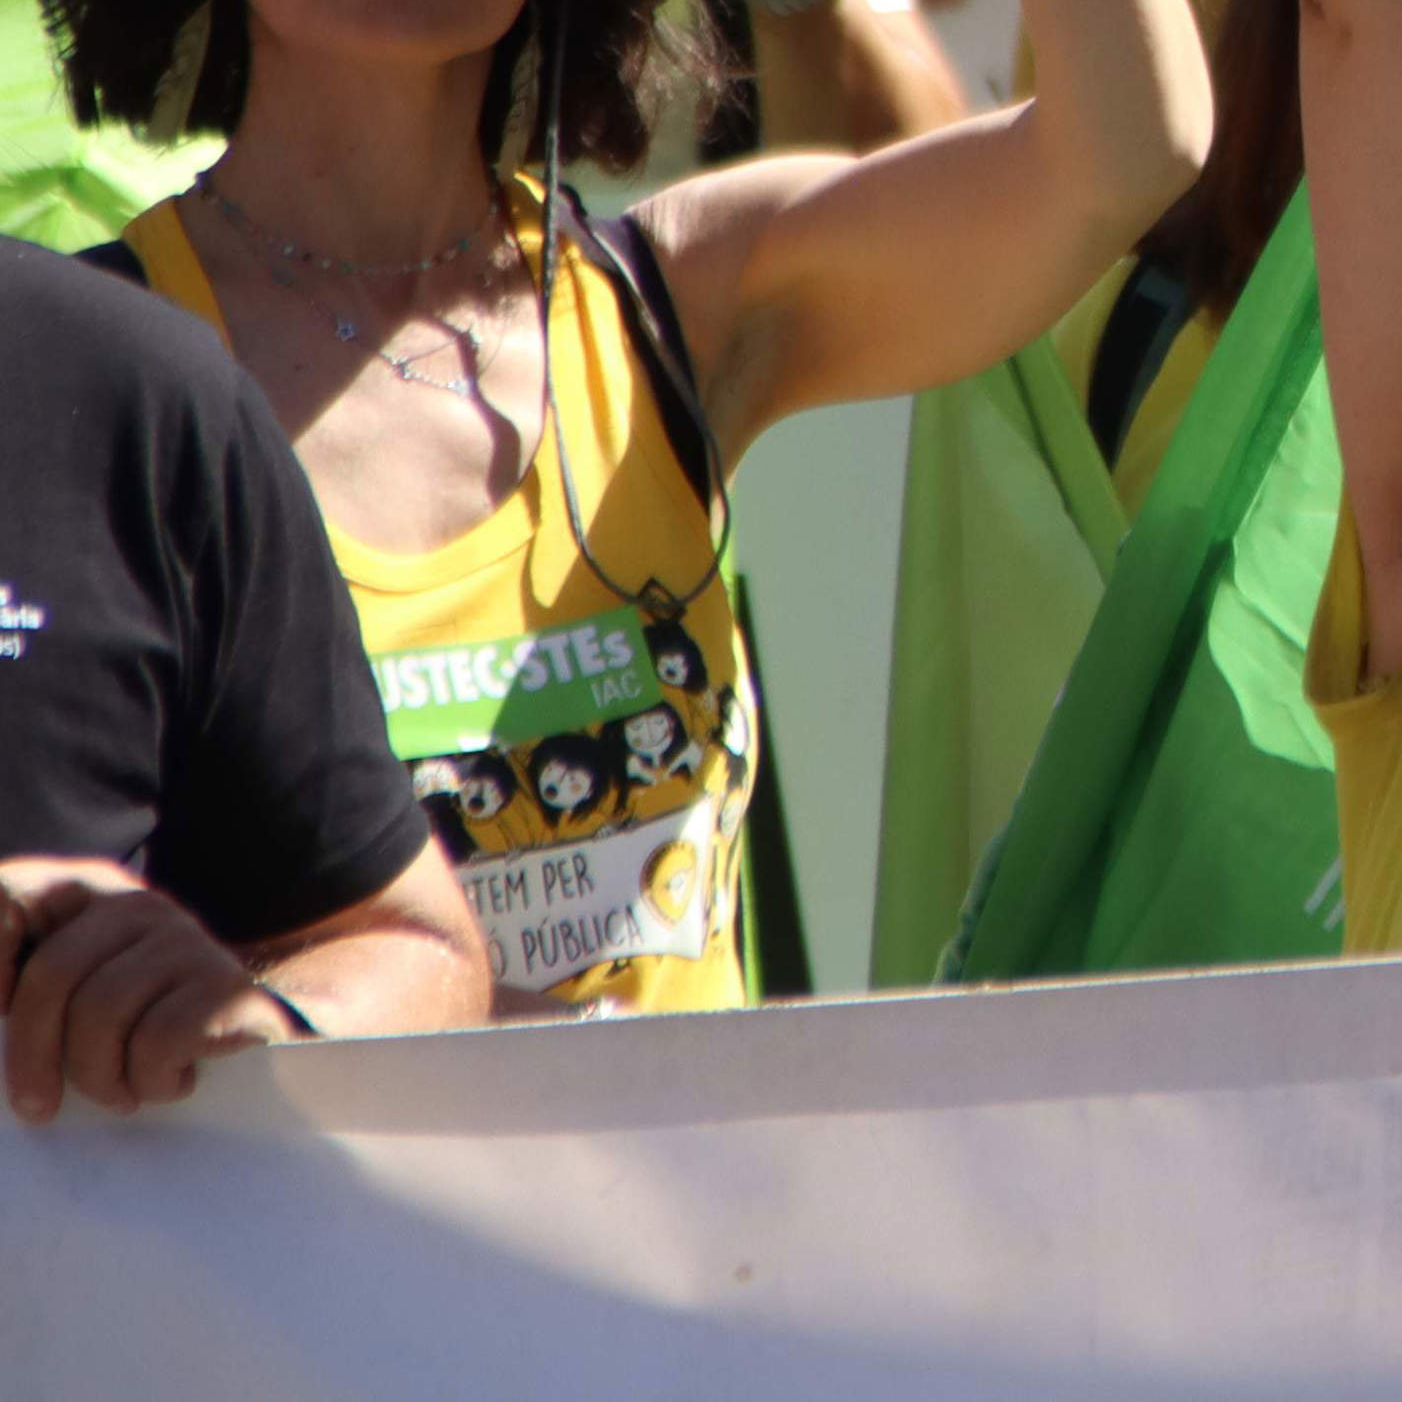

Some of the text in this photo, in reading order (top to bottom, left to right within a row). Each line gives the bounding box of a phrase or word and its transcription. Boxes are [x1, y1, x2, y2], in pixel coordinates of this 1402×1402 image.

[590, 670, 643, 709] IAC
[542, 853, 594, 906] PER
[521, 902, 645, 975] PÚBLICA
